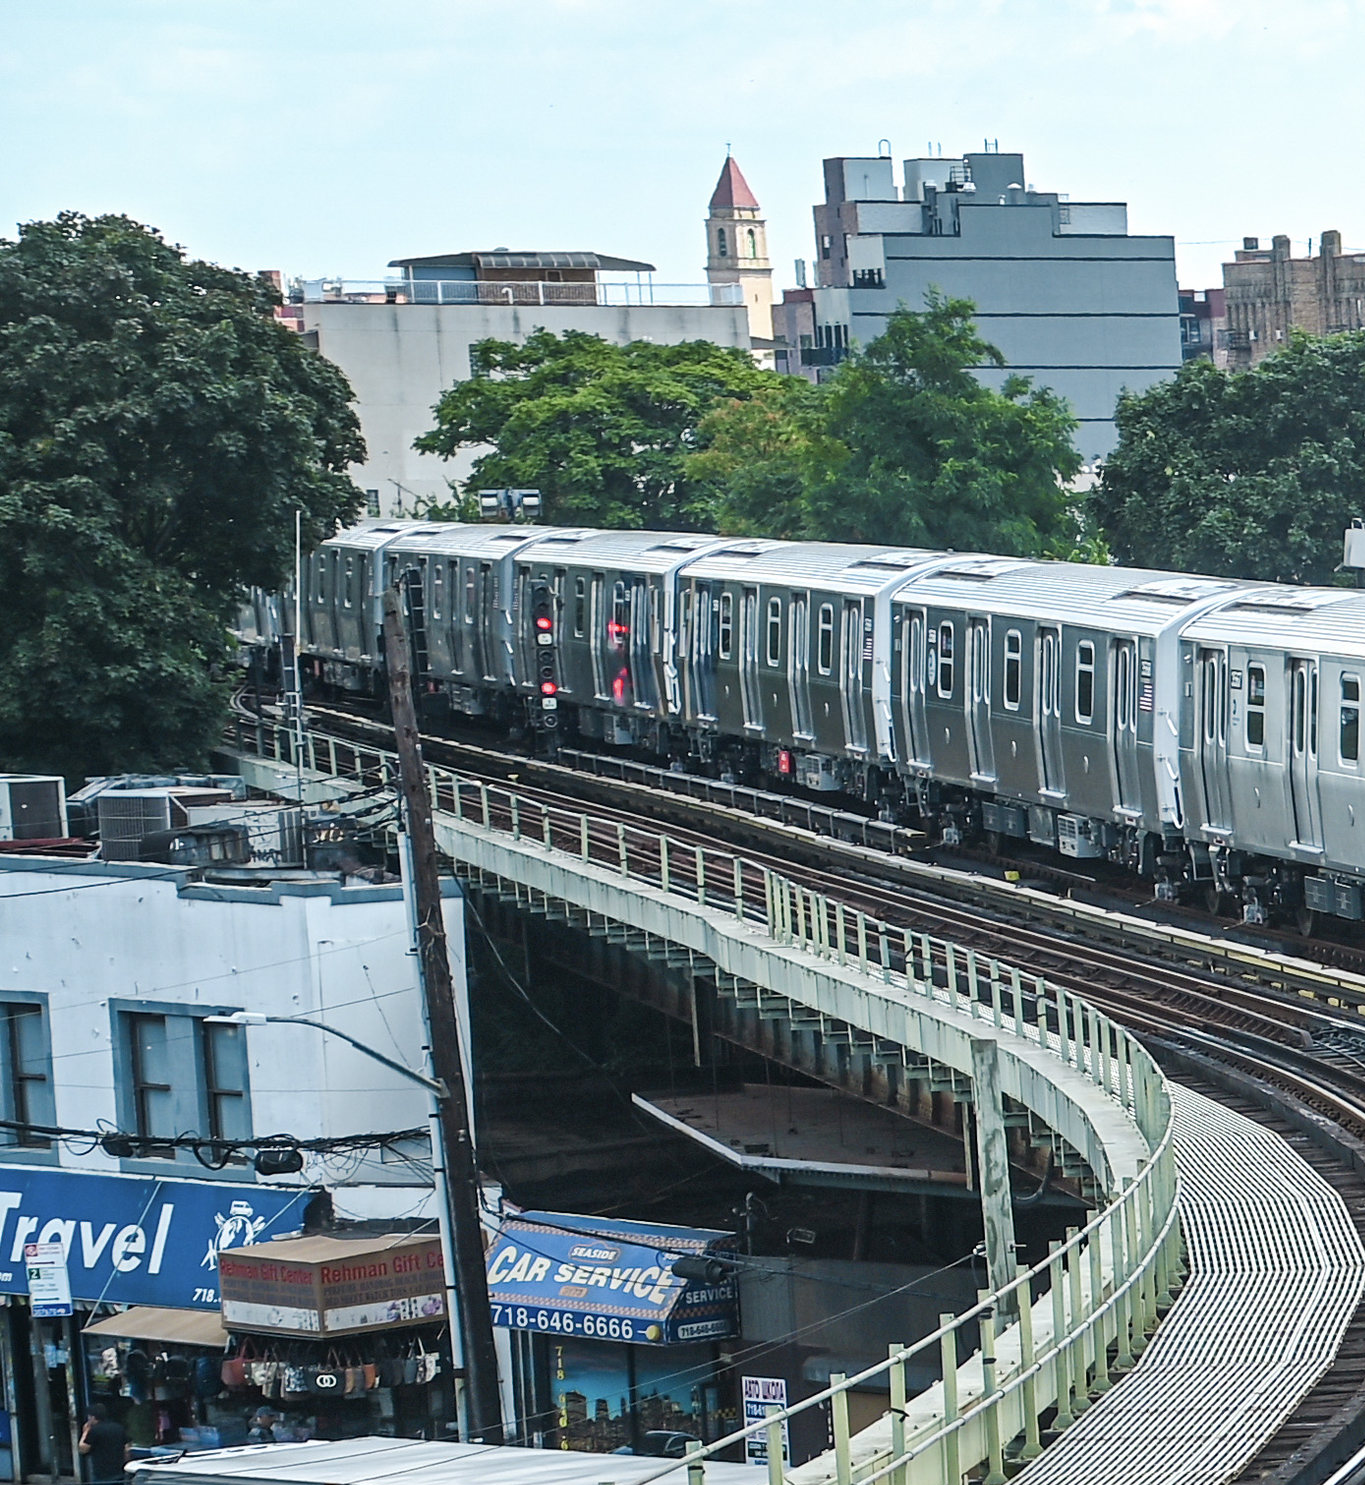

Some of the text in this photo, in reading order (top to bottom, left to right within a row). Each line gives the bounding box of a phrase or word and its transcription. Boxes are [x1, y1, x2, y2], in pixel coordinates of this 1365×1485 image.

[571, 1247, 617, 1260] SEASIDE
[31, 1269, 38, 1279] 2
[220, 1259, 312, 1285] Rehman Gift Center
[321, 1263, 388, 1284] Rehman
[393, 1254, 420, 1273] Gift
[487, 1246, 677, 1305] CAR SERVICE
[686, 1287, 734, 1304] SERVICE
[490, 1304, 634, 1339] 718-646-6666
